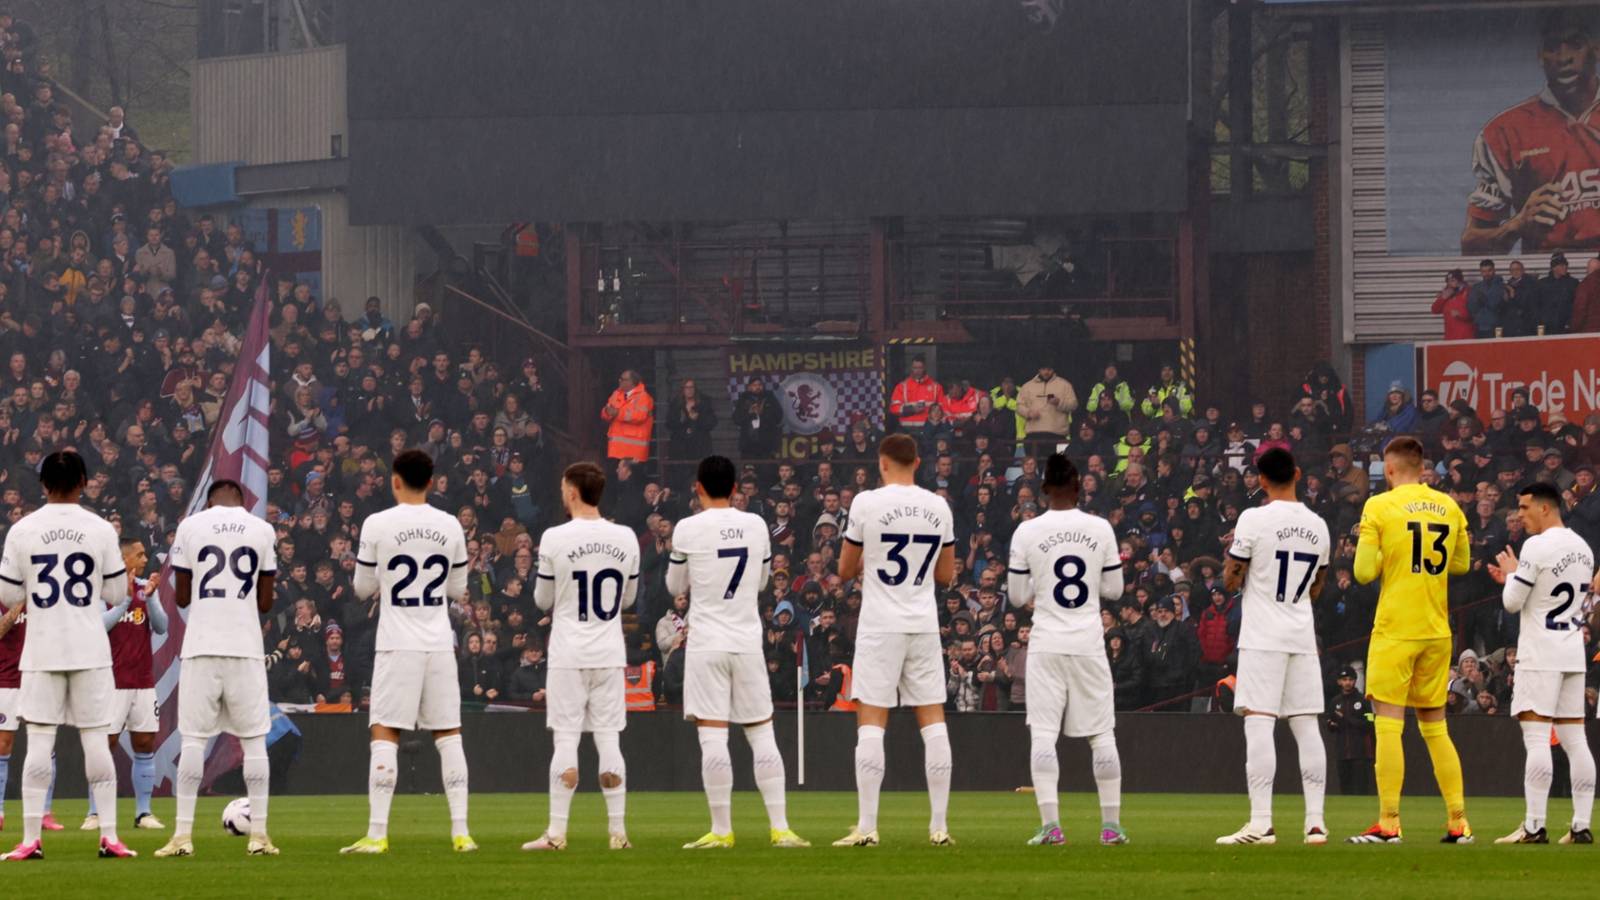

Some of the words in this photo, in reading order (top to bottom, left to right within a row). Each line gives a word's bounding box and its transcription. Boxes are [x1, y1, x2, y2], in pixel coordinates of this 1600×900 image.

[729, 350, 875, 373] HAMPSHIRE
[880, 508, 902, 526] VAN
[905, 506, 919, 517] DE
[923, 508, 942, 528] VEN
[1405, 502, 1446, 517] VICARIO
[41, 528, 86, 544] UDOGIE
[212, 523, 246, 534] SARR
[394, 528, 448, 546] JOHNSON
[720, 528, 744, 540] SON
[1276, 527, 1319, 545] ROMERO
[567, 543, 627, 563] MADDISON
[1038, 532, 1098, 553] BISSOUMA
[1407, 522, 1450, 576] 13
[877, 533, 942, 586] 37
[1551, 552, 1577, 577] PEDRO
[30, 552, 95, 609] 38
[197, 545, 259, 600] 29
[387, 554, 449, 607] 22
[717, 547, 749, 600] 7
[1053, 555, 1089, 609] 8
[1275, 550, 1320, 604] 17
[572, 568, 624, 622] 10
